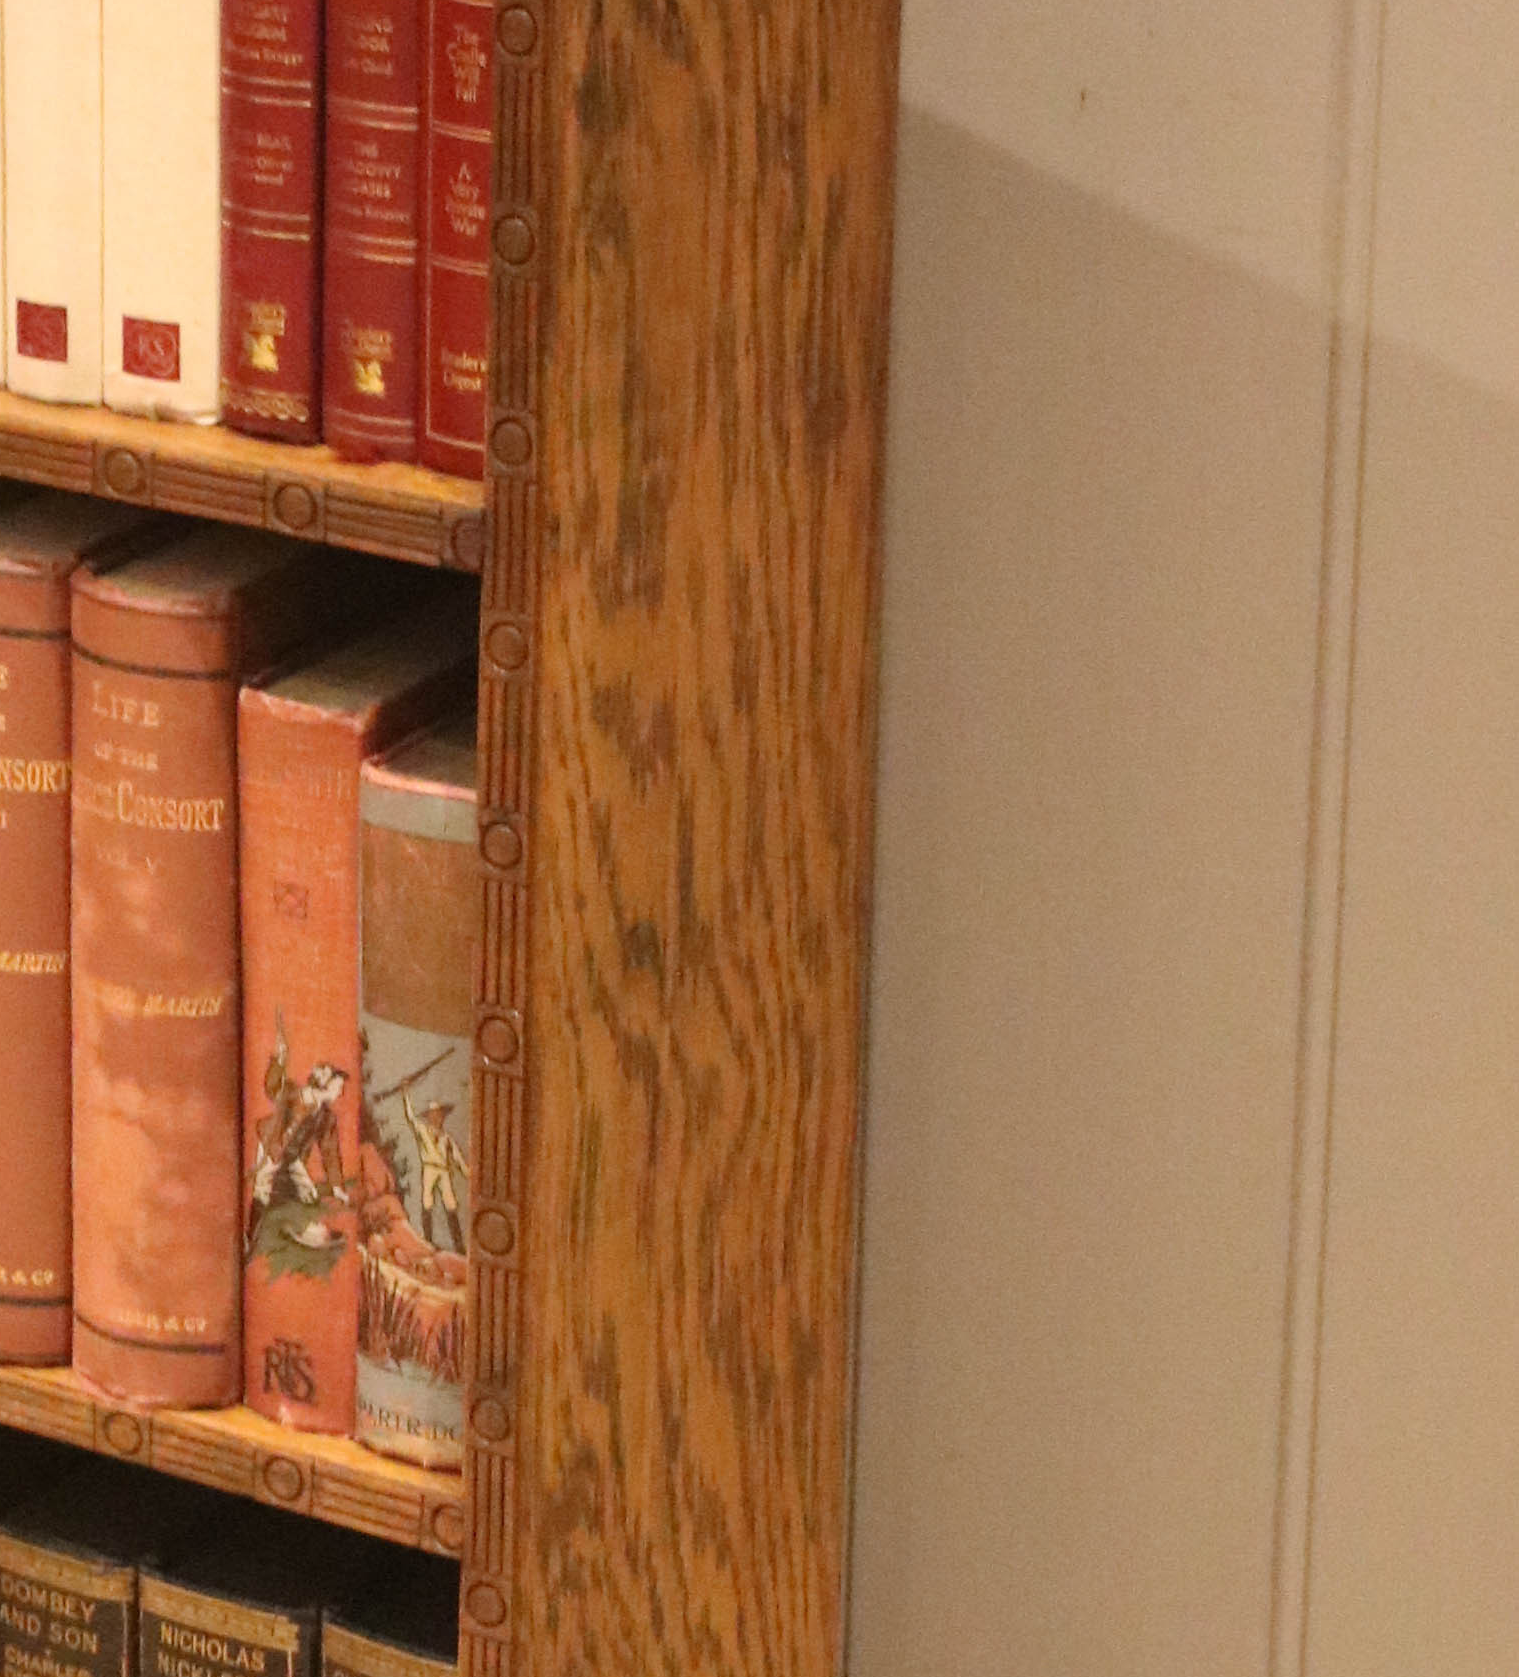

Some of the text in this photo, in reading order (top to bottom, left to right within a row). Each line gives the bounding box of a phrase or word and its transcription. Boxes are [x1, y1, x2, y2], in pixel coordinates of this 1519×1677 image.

[92, 681, 161, 727] LIFE
[94, 740, 159, 772] OF THE
[116, 779, 226, 832] CONSORT
[143, 994, 223, 1018] MARTIN
[0, 1574, 97, 1623] DOMBEY
[0, 1602, 99, 1655] AND SON
[160, 1621, 266, 1673] NICHOLAS
